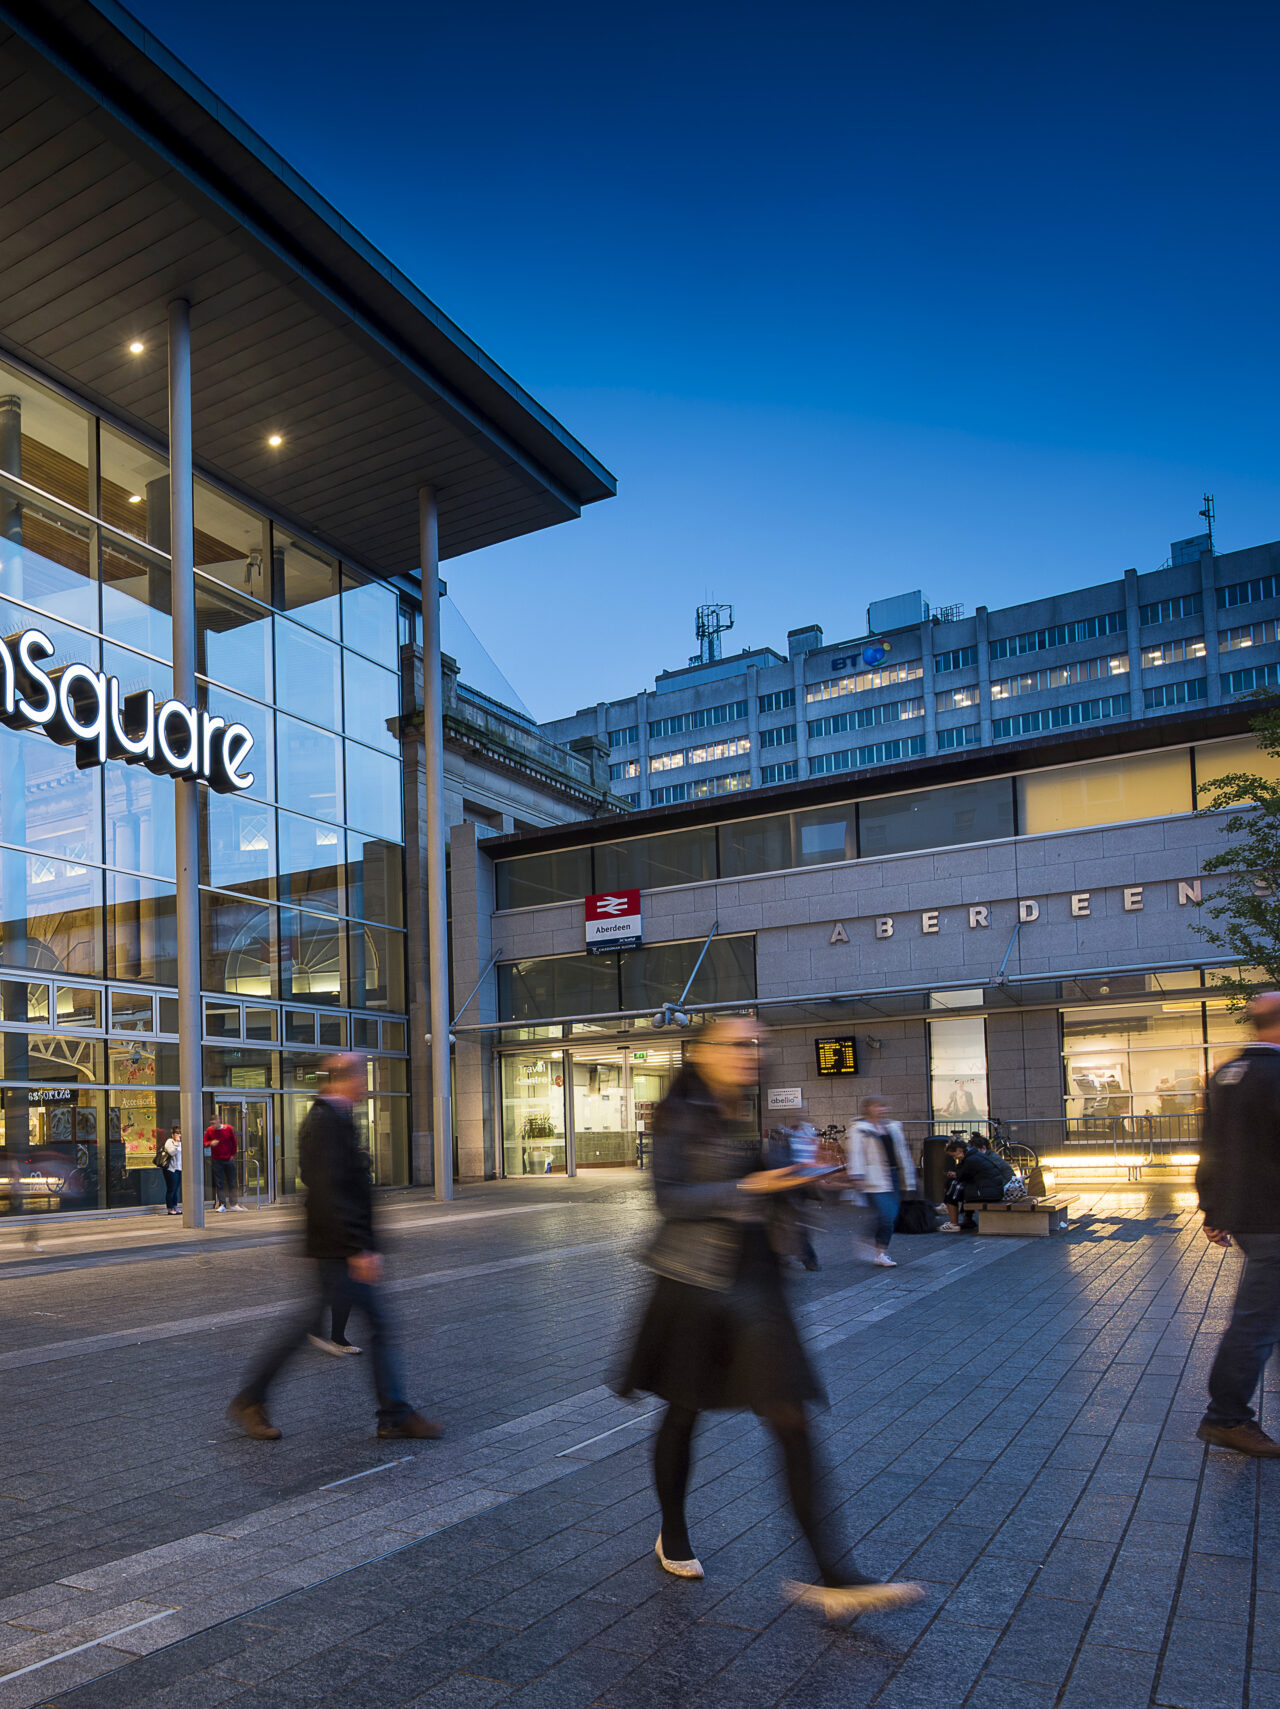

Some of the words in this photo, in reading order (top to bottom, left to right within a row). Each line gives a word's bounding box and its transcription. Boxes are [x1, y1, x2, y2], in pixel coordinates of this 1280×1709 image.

[831, 652, 861, 671] BT
[830, 880, 1202, 944] ABERDEEN
[596, 924, 631, 935] Aberdeen
[771, 1096, 794, 1105] abellio
